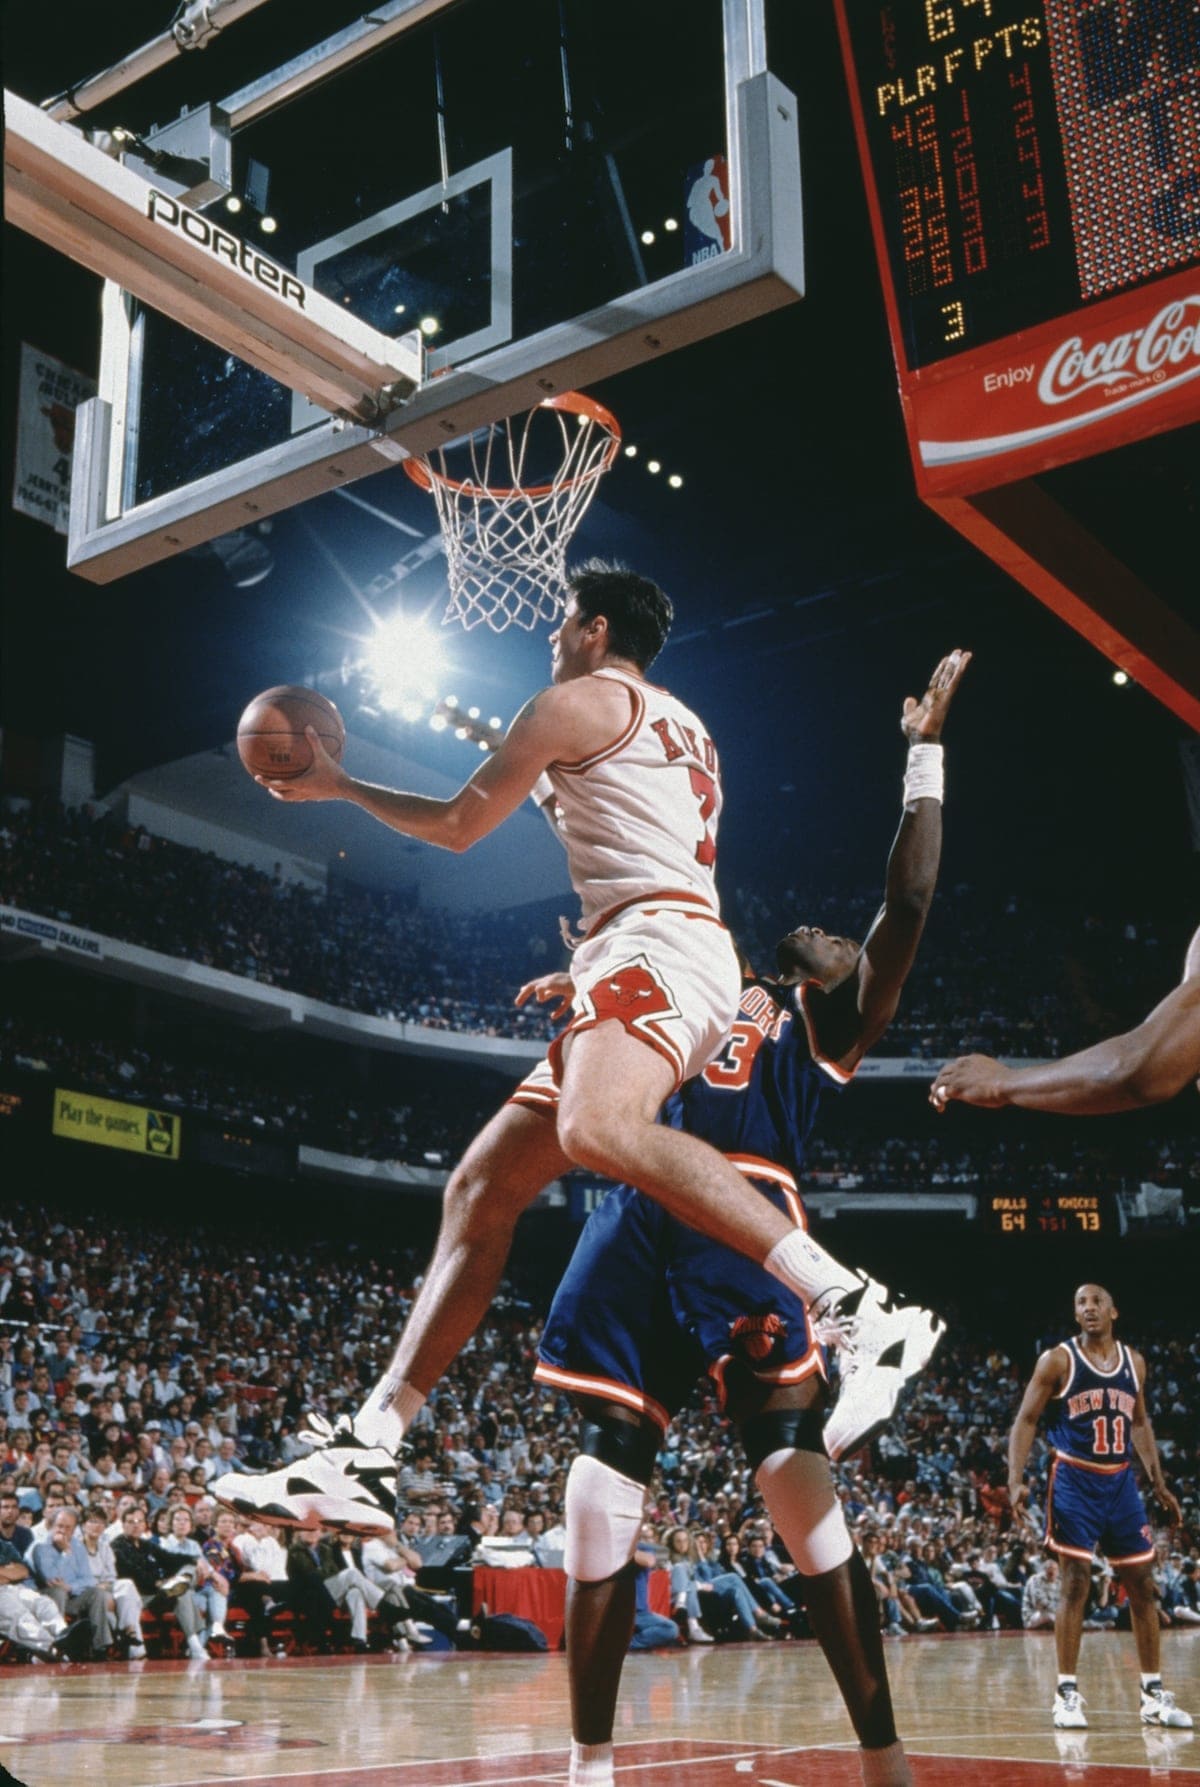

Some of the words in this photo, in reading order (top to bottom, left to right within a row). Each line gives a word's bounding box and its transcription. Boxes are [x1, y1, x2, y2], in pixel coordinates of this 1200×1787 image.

[877, 65, 937, 116] PLR
[944, 48, 964, 84] F
[973, 17, 1042, 71] PTS
[891, 104, 937, 147] 42
[692, 243, 719, 265] NBA
[941, 301, 965, 342] 3
[984, 364, 1036, 393] Enjoy
[59, 1101, 83, 1125] Play
[85, 1105, 104, 1127] the
[992, 1197, 1027, 1210] BULLS
[1058, 1197, 1099, 1210] KNICKS
[1001, 1213, 1026, 1231] 64
[1075, 1212, 1100, 1231] 73
[1092, 1415, 1125, 1455] 11
